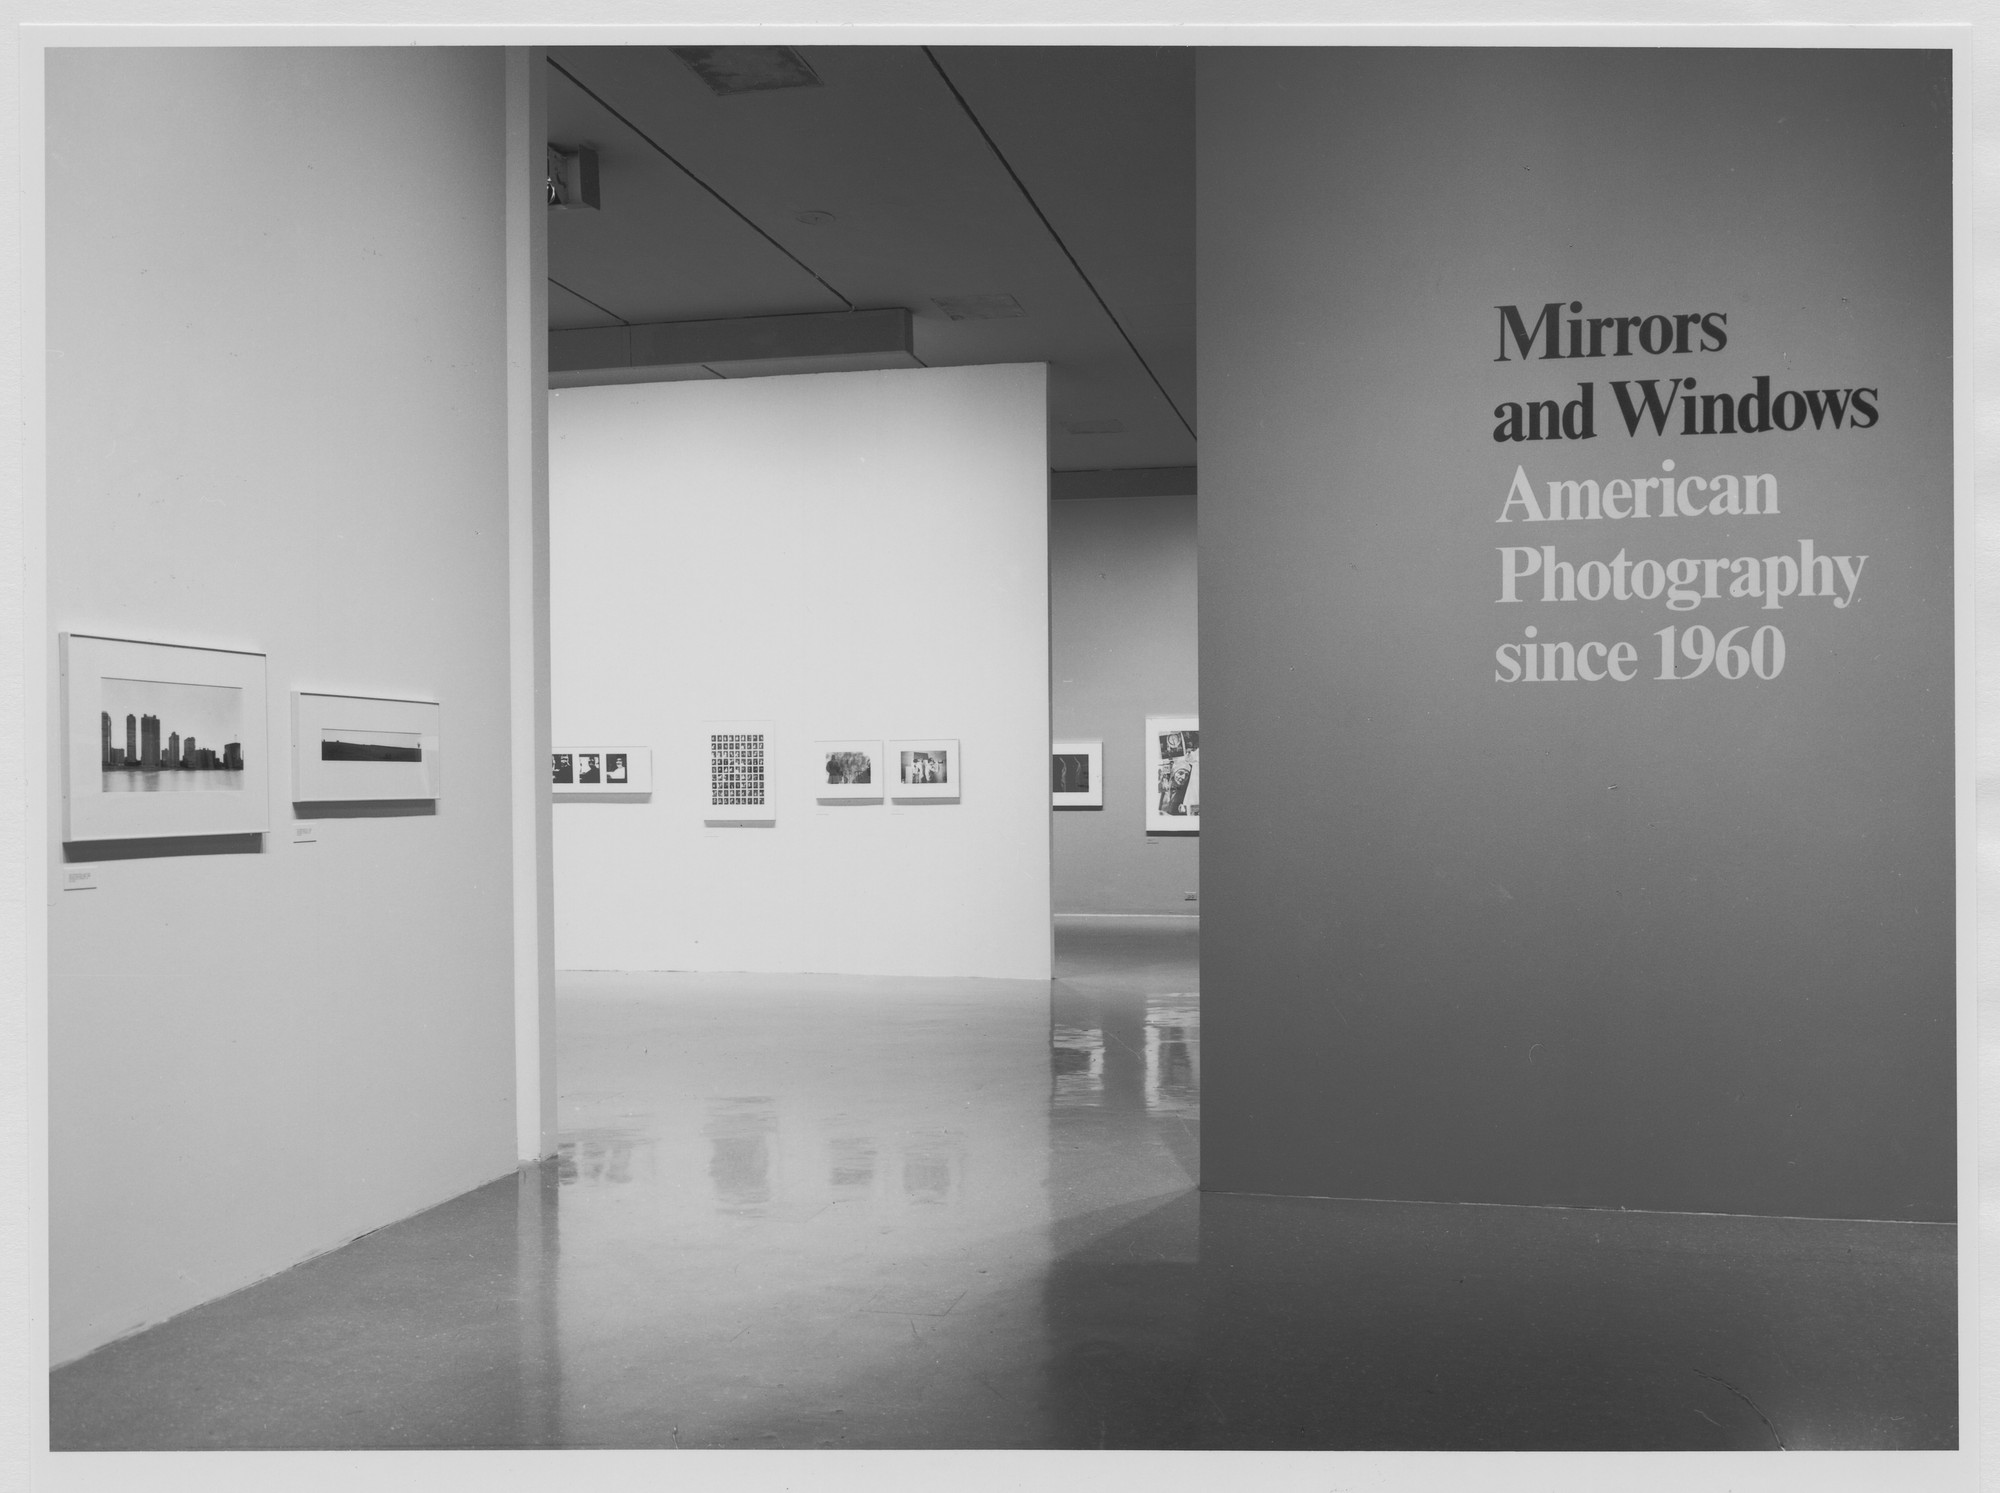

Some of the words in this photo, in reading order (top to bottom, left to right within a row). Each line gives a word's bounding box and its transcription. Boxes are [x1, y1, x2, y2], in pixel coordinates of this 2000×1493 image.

[1494, 301, 1727, 362] Mirrors
[1493, 382, 1597, 442] and
[1609, 376, 1879, 437] Windows
[1496, 459, 1780, 522] American
[1496, 539, 1869, 611] Photography
[1496, 625, 1637, 682] since
[1654, 625, 1785, 680] 1960
